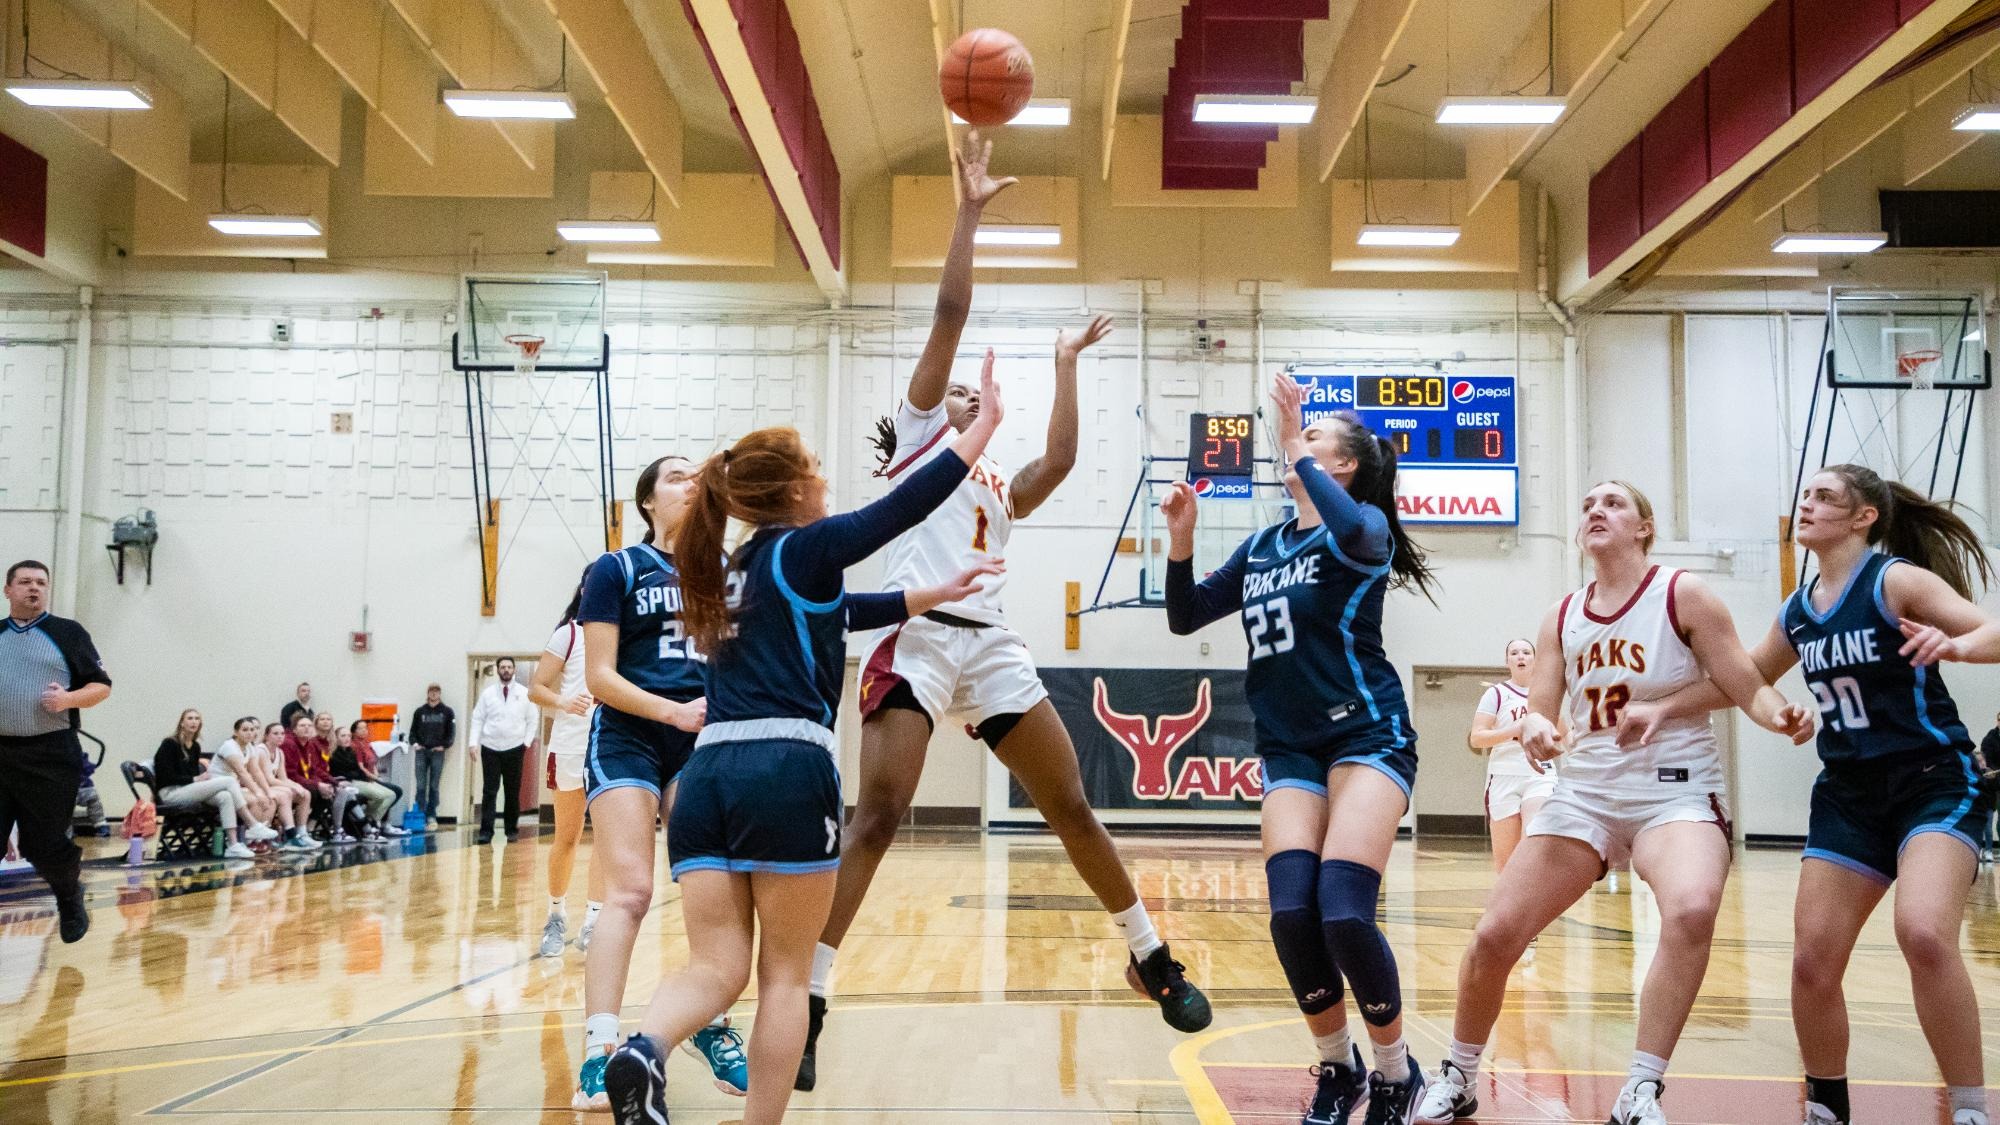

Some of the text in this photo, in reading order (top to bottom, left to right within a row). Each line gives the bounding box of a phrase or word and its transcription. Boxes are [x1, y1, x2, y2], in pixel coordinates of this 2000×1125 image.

[1378, 377, 1442, 406] 8:50
[1476, 387, 1511, 399] pepsi
[1304, 410, 1342, 425] HOM
[1384, 418, 1418, 429] PERIOD
[1456, 412, 1500, 426] GUEST
[1208, 418, 1249, 437] 8:50
[1204, 438, 1240, 467] 27
[1484, 430, 1501, 458] 0
[1216, 484, 1249, 495] pepsi
[1396, 496, 1502, 515] AKIMA
[972, 505, 988, 553] 1
[1245, 596, 1296, 661] 23
[1808, 675, 1870, 732] 20
